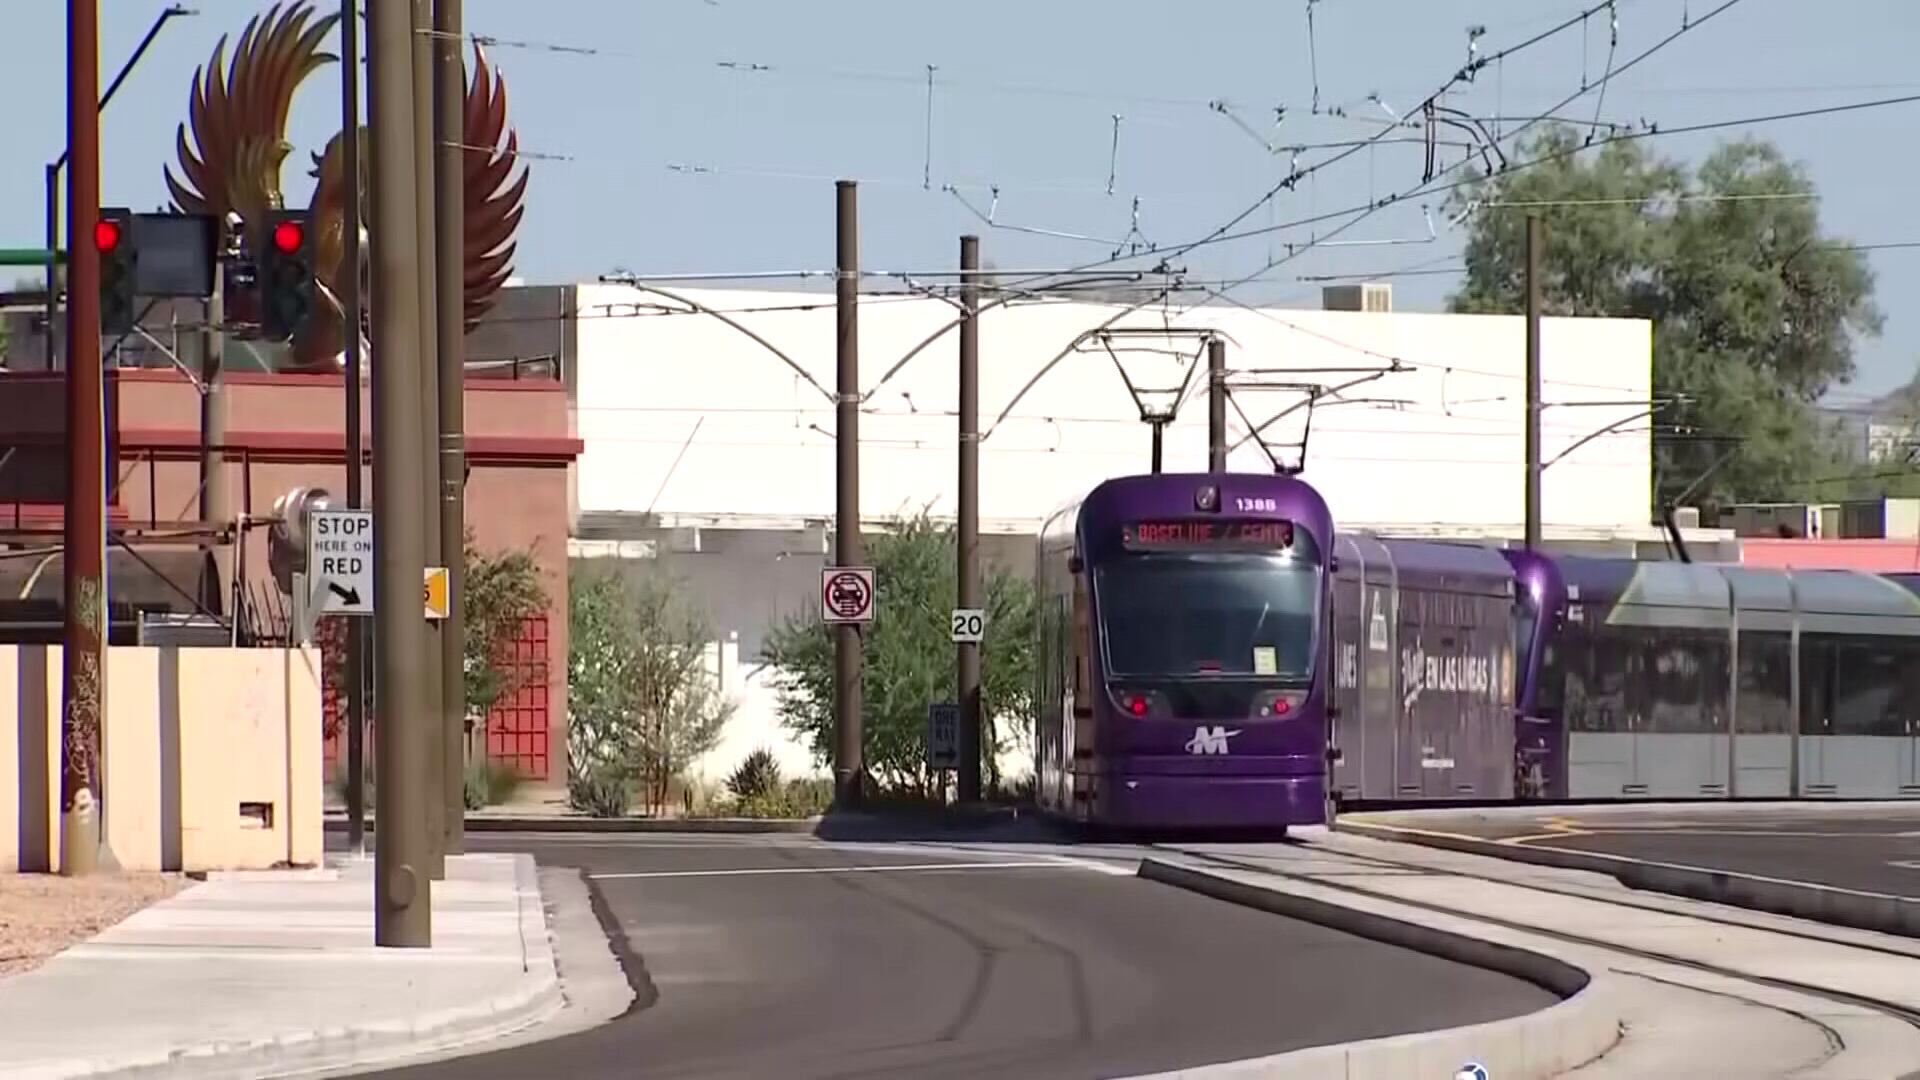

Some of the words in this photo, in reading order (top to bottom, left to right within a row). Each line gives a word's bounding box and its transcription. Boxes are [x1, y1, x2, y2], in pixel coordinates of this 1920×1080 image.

[318, 518, 369, 535] STOP
[1138, 524, 1213, 543] BASELINE
[315, 540, 348, 551] HERE
[354, 541, 371, 552] ON
[323, 558, 362, 575] RED
[953, 615, 982, 635] 20
[1440, 656, 1457, 690] LAS
